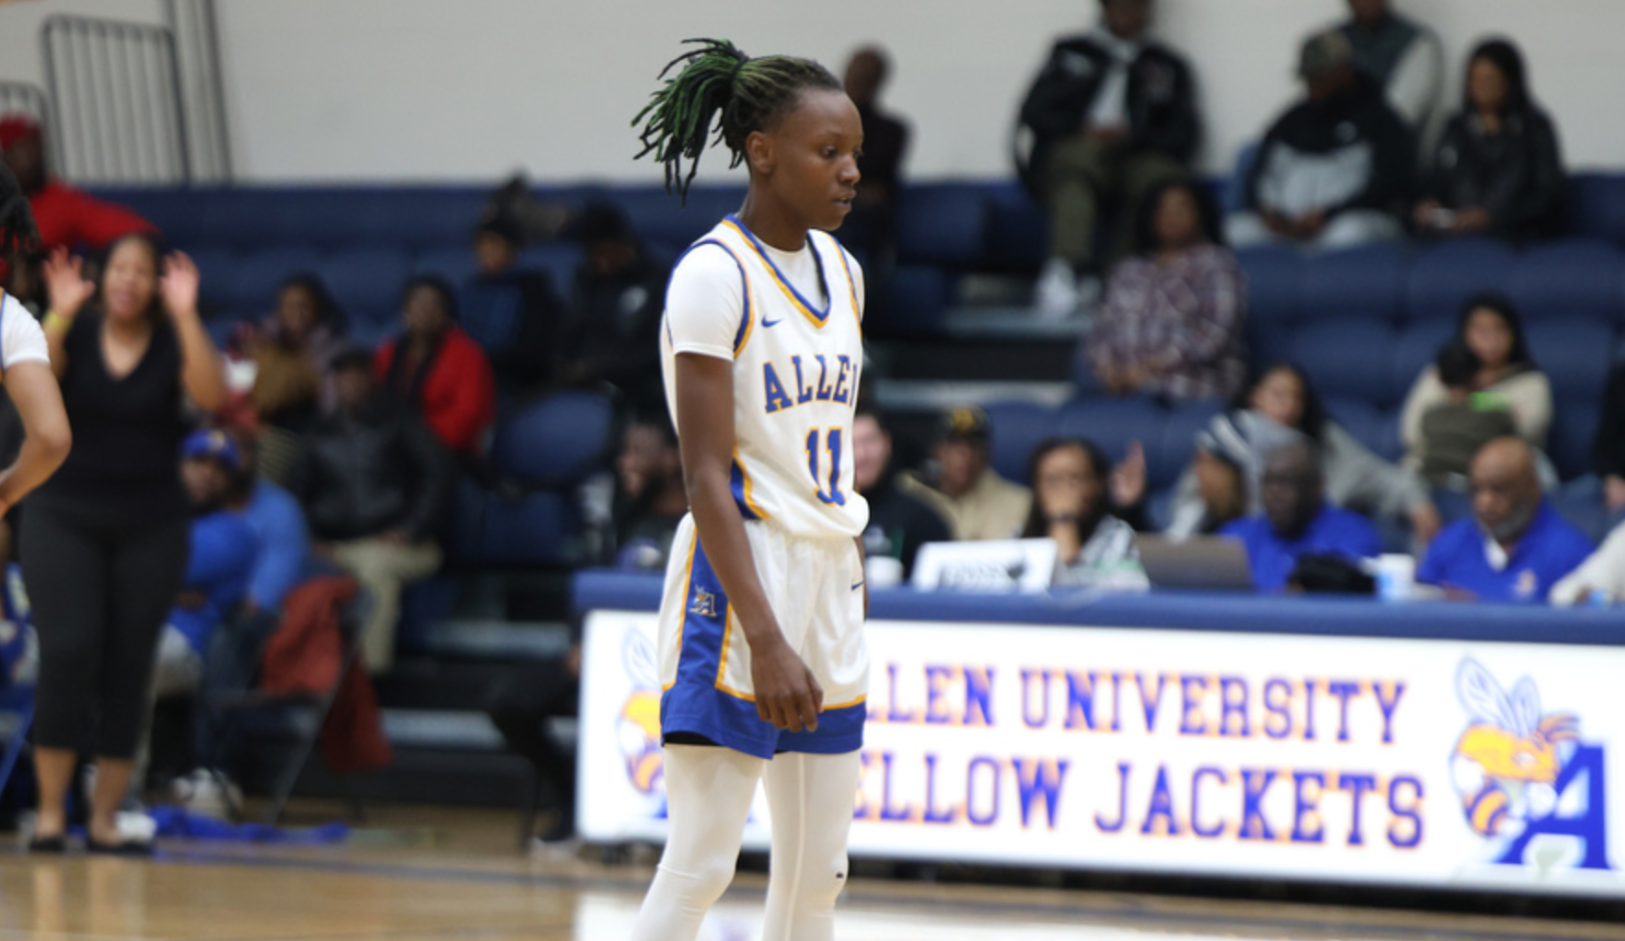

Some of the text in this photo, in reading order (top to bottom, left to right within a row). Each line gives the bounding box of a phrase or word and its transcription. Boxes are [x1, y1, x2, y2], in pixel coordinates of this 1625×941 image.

[805, 425, 846, 507] 11
[866, 662, 1407, 745] LEN UNIVERSITY
[1091, 762, 1426, 850] JACKETS
